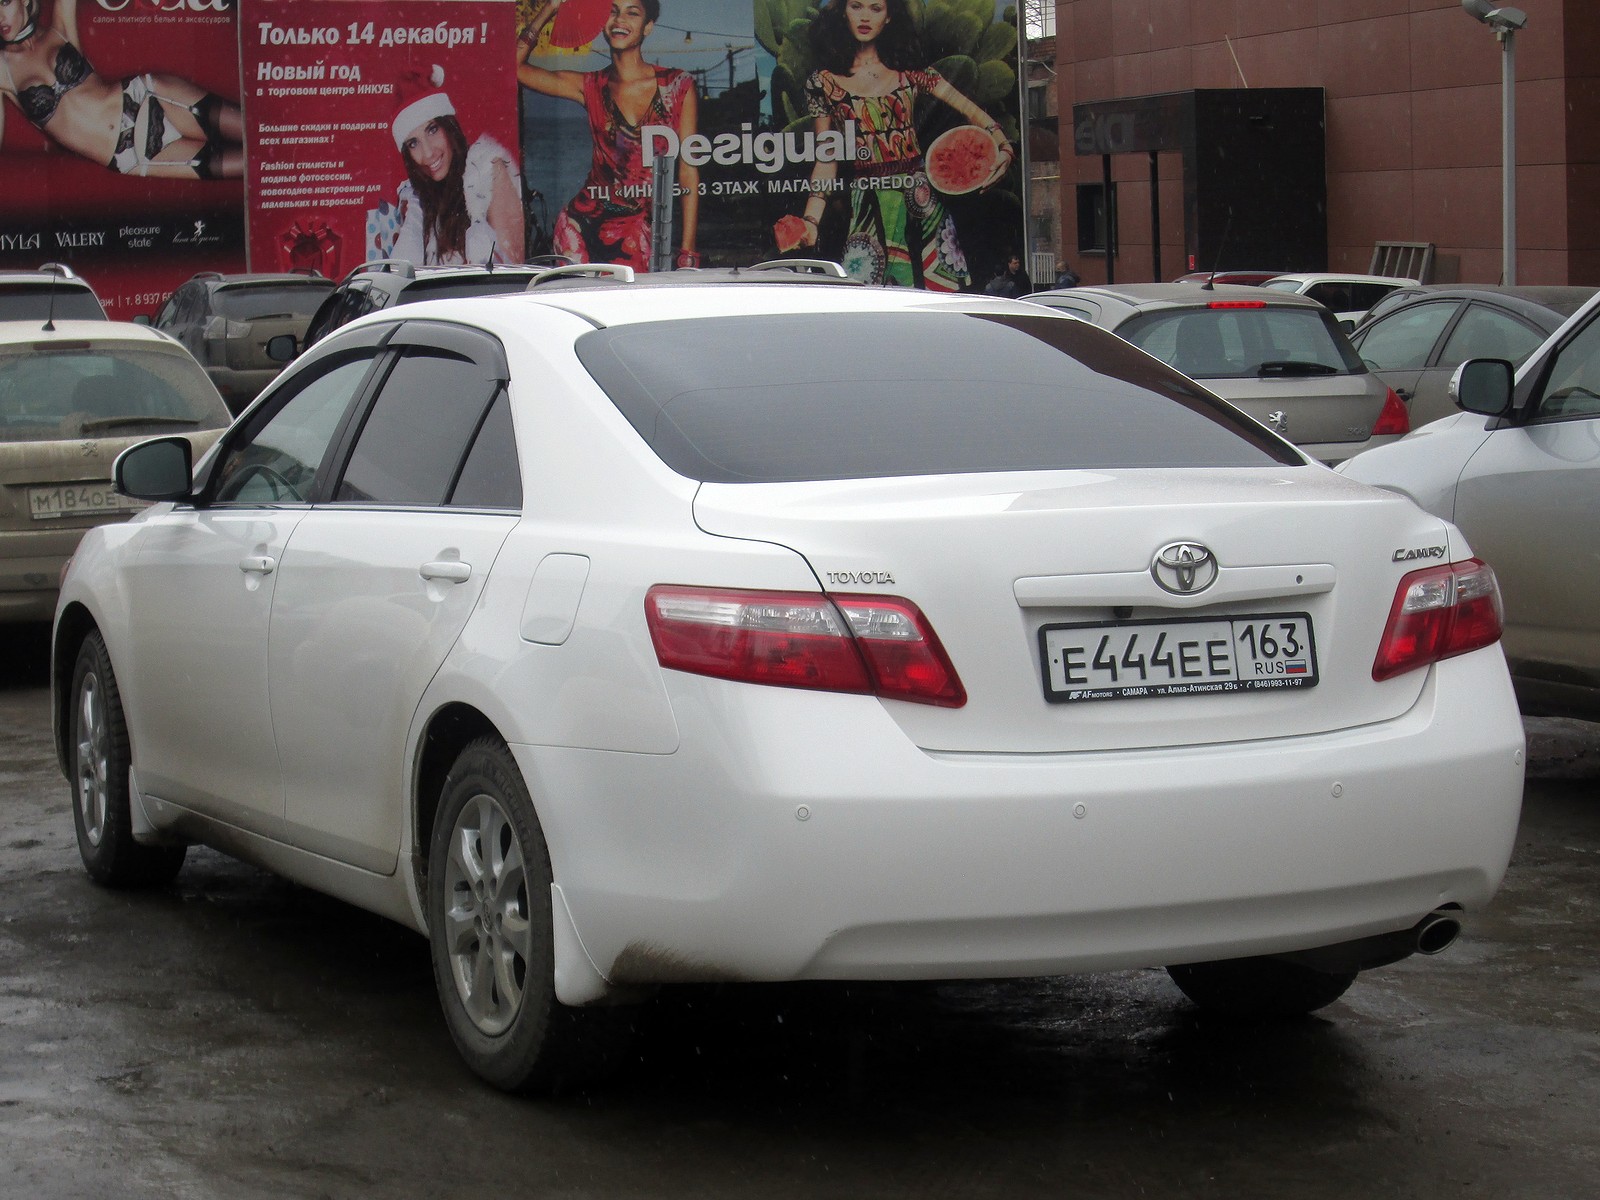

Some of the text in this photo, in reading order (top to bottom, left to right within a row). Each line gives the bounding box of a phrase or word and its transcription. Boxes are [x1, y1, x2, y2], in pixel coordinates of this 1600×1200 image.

[92, 16, 116, 24] салон
[117, 15, 152, 24] элитного
[154, 15, 176, 23] белья
[185, 16, 231, 25] аксессуаров
[258, 21, 488, 48] Только 14 декабря !
[257, 60, 361, 82] Новый год
[268, 86, 317, 98] торговом
[319, 86, 355, 97] центре
[357, 84, 393, 95] ИНКУБ!
[258, 122, 388, 132] Большие скидки и подарки во
[259, 138, 280, 146] всех
[281, 136, 329, 145] магазинах
[260, 161, 294, 171] Fashion
[296, 160, 337, 169] стилисты
[260, 173, 353, 184] модные фотосессии,
[261, 184, 381, 197] новогоднее настроение для
[588, 174, 924, 201] ТЦ «ИНБ» 3 ЭТАЖ МАГАЗИН «CREDO»
[261, 201, 310, 209] маленьких
[320, 196, 364, 207] взрослых!
[119, 225, 161, 237] pleasure
[55, 231, 106, 247] VALERY
[127, 239, 151, 248] state
[135, 294, 142, 306] 8
[143, 293, 160, 305] 937
[827, 571, 895, 584] TOYOTA
[1239, 623, 1299, 659] 163
[1254, 661, 1285, 675] RUS
[1122, 687, 1149, 697] САМАРА
[1168, 683, 1223, 694] Алма-Атинская
[1254, 679, 1303, 688] (846)993-11-97
